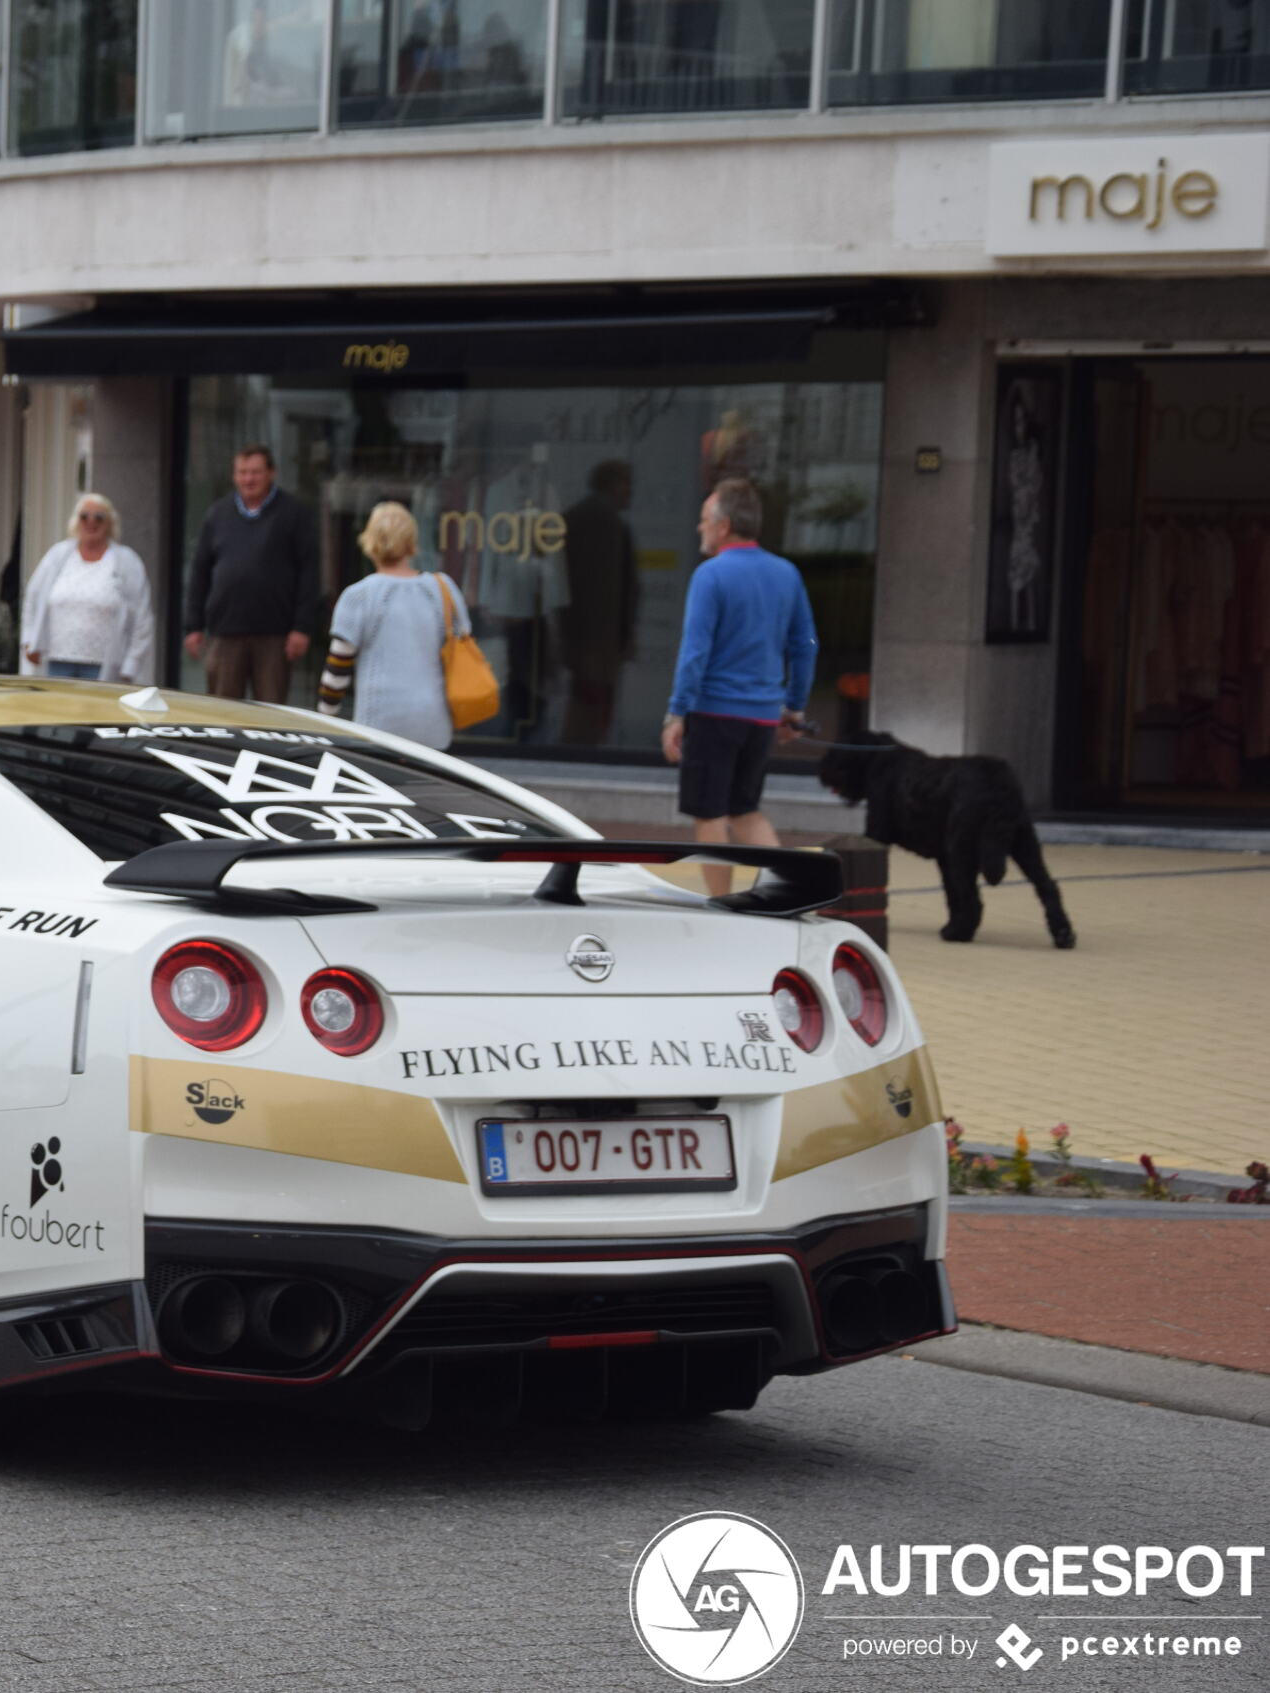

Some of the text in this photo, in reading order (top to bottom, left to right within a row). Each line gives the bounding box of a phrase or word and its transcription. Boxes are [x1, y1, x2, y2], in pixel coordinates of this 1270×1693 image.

[1027, 156, 1221, 230] maje
[342, 339, 410, 373] maje
[439, 500, 567, 563] maje
[94, 726, 334, 746] EAGLE RUN
[7, 909, 100, 939] RUN
[398, 1039, 798, 1080] FLYING LIKE AN EAGLE
[488, 1157, 504, 1177] B
[1, 1203, 105, 1252] foubert
